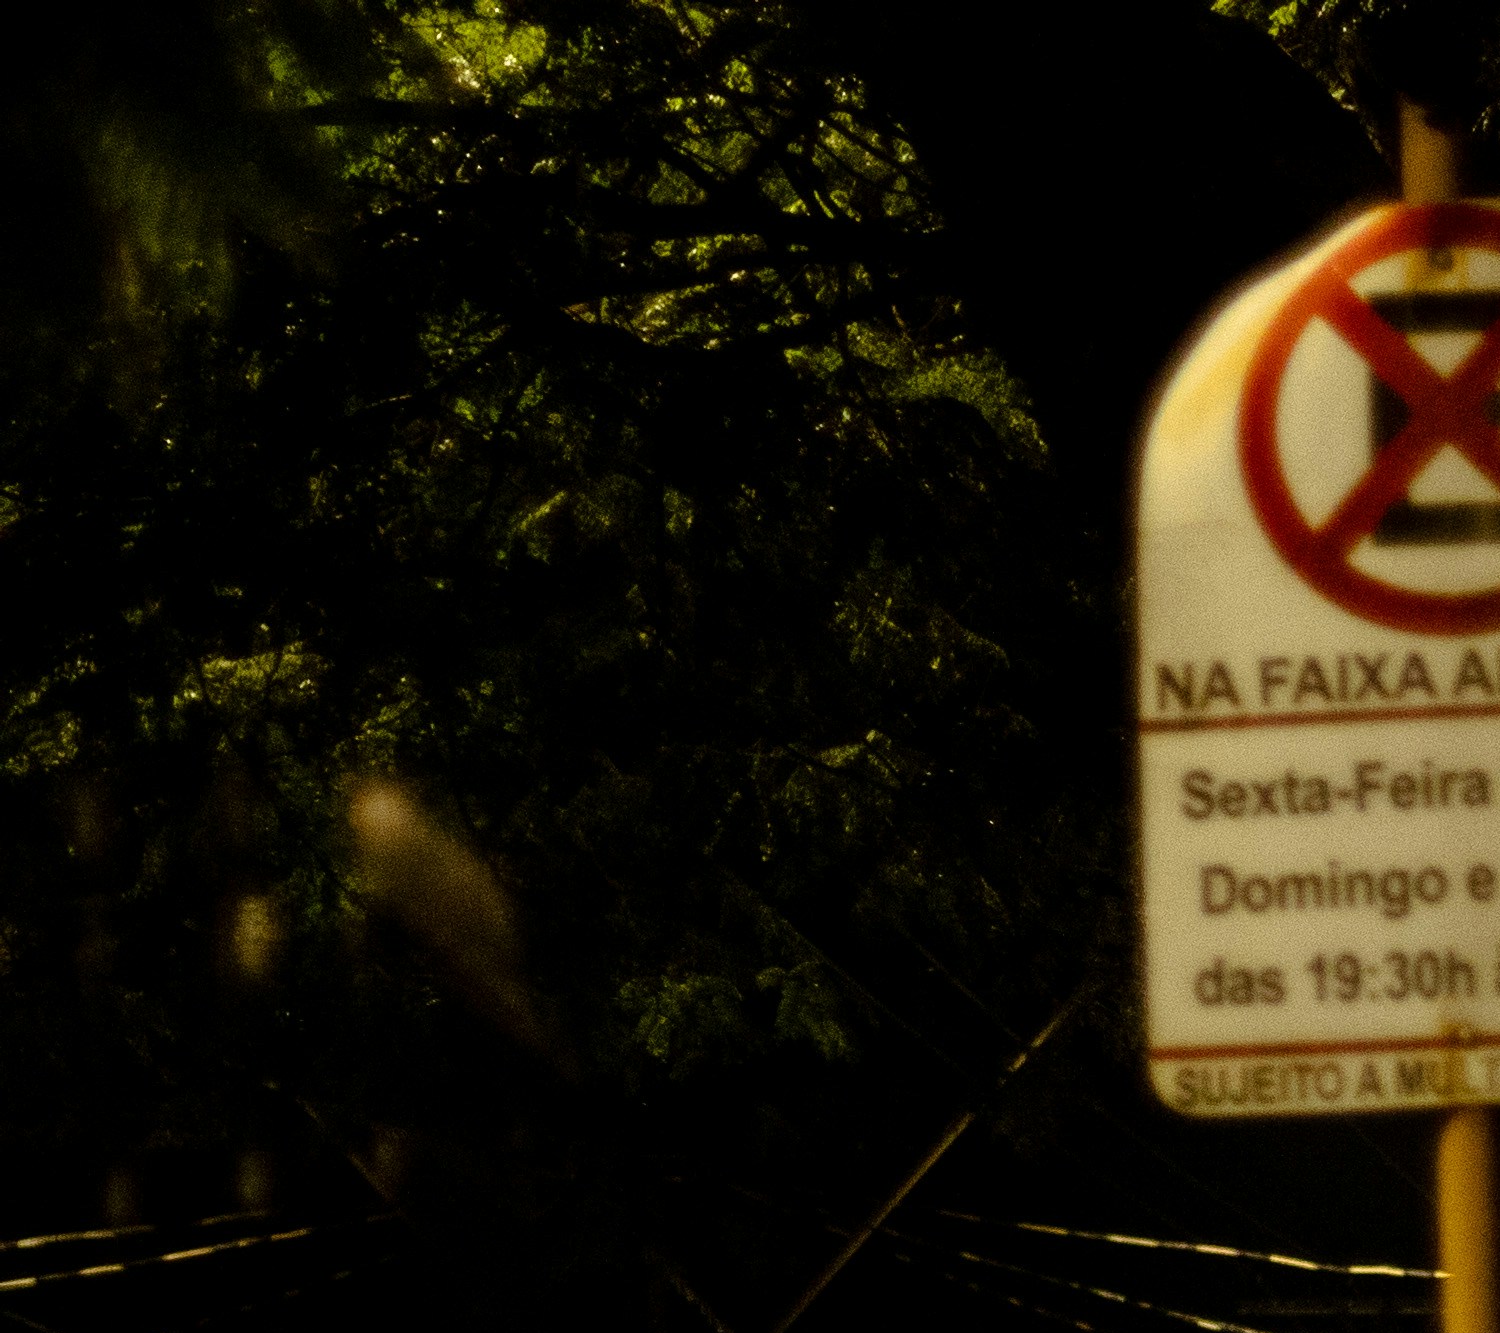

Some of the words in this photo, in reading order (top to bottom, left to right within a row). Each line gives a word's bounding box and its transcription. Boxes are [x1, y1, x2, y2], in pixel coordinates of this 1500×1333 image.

[1154, 660, 1242, 710] NA
[1257, 649, 1440, 706] FAIXA
[1180, 758, 1492, 820] Sexta-Feira
[1200, 857, 1450, 919] Domingo
[1463, 862, 1496, 902] e
[1194, 955, 1286, 1005] das
[1305, 947, 1477, 1001] 19:30h
[1174, 1058, 1345, 1108] SUJEITO
[1357, 1060, 1387, 1100] A
